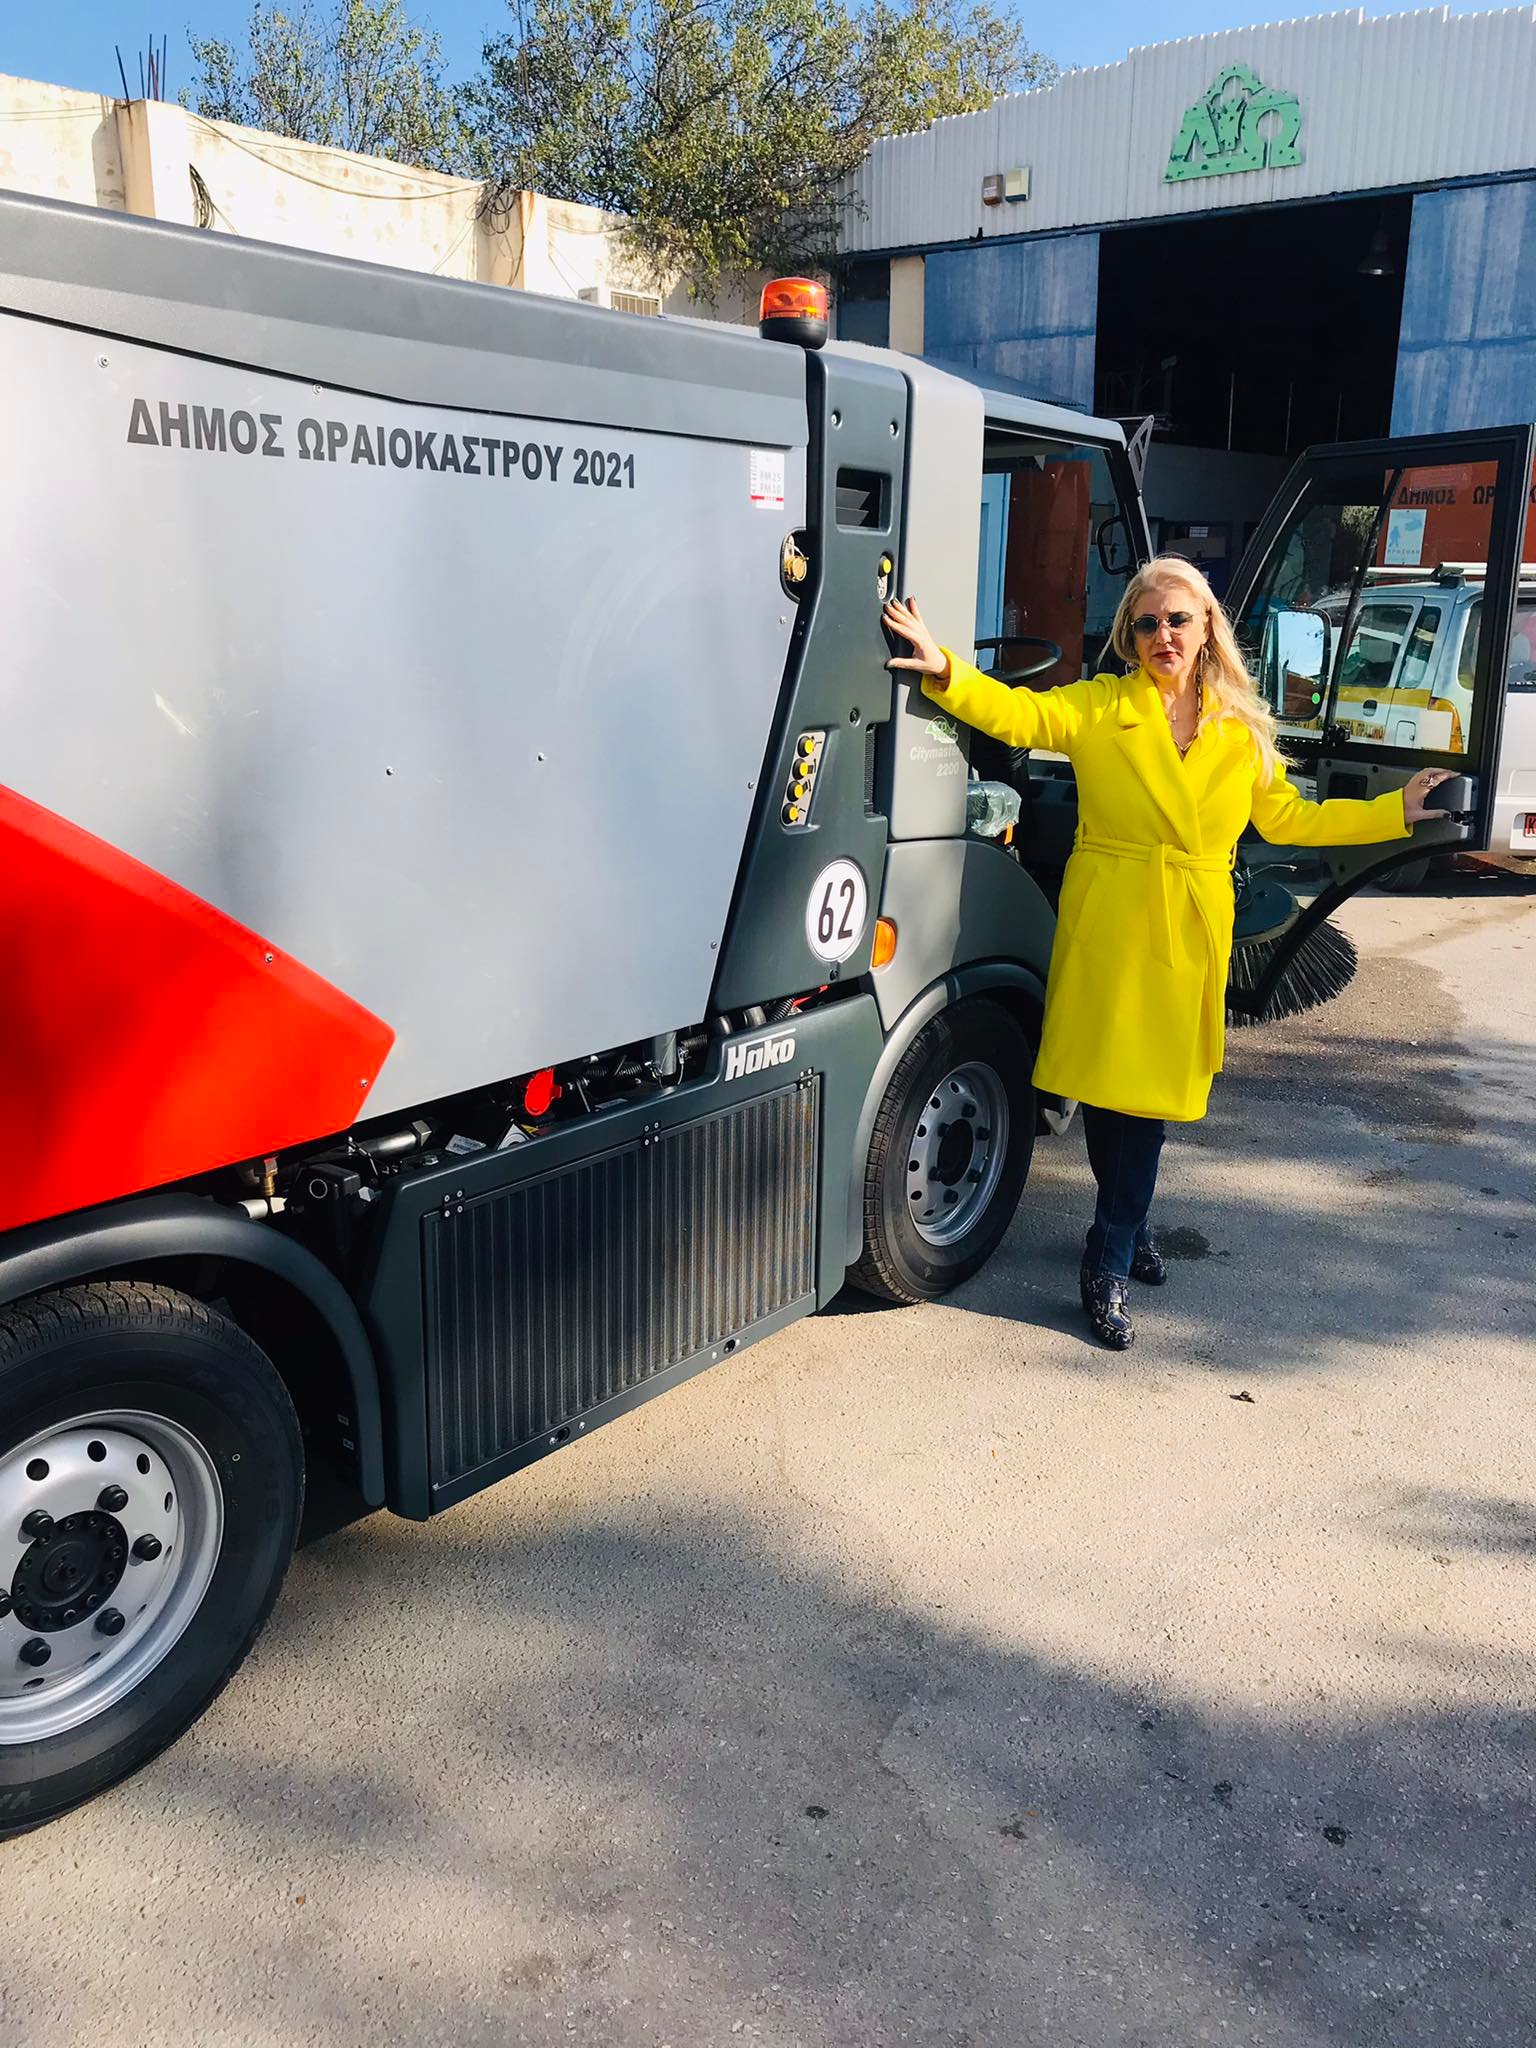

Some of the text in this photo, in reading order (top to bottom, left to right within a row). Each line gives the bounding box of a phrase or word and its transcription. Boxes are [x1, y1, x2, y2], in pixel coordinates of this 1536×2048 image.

[127, 398, 636, 489] ΔΗΜΟΣ ΩΡΑΙΟΚΑΣΤΡΟΥ 2021
[1398, 487, 1456, 505] ΔΗΜΟΣ
[818, 878, 855, 944] 62
[725, 1030, 796, 1082] Hako
